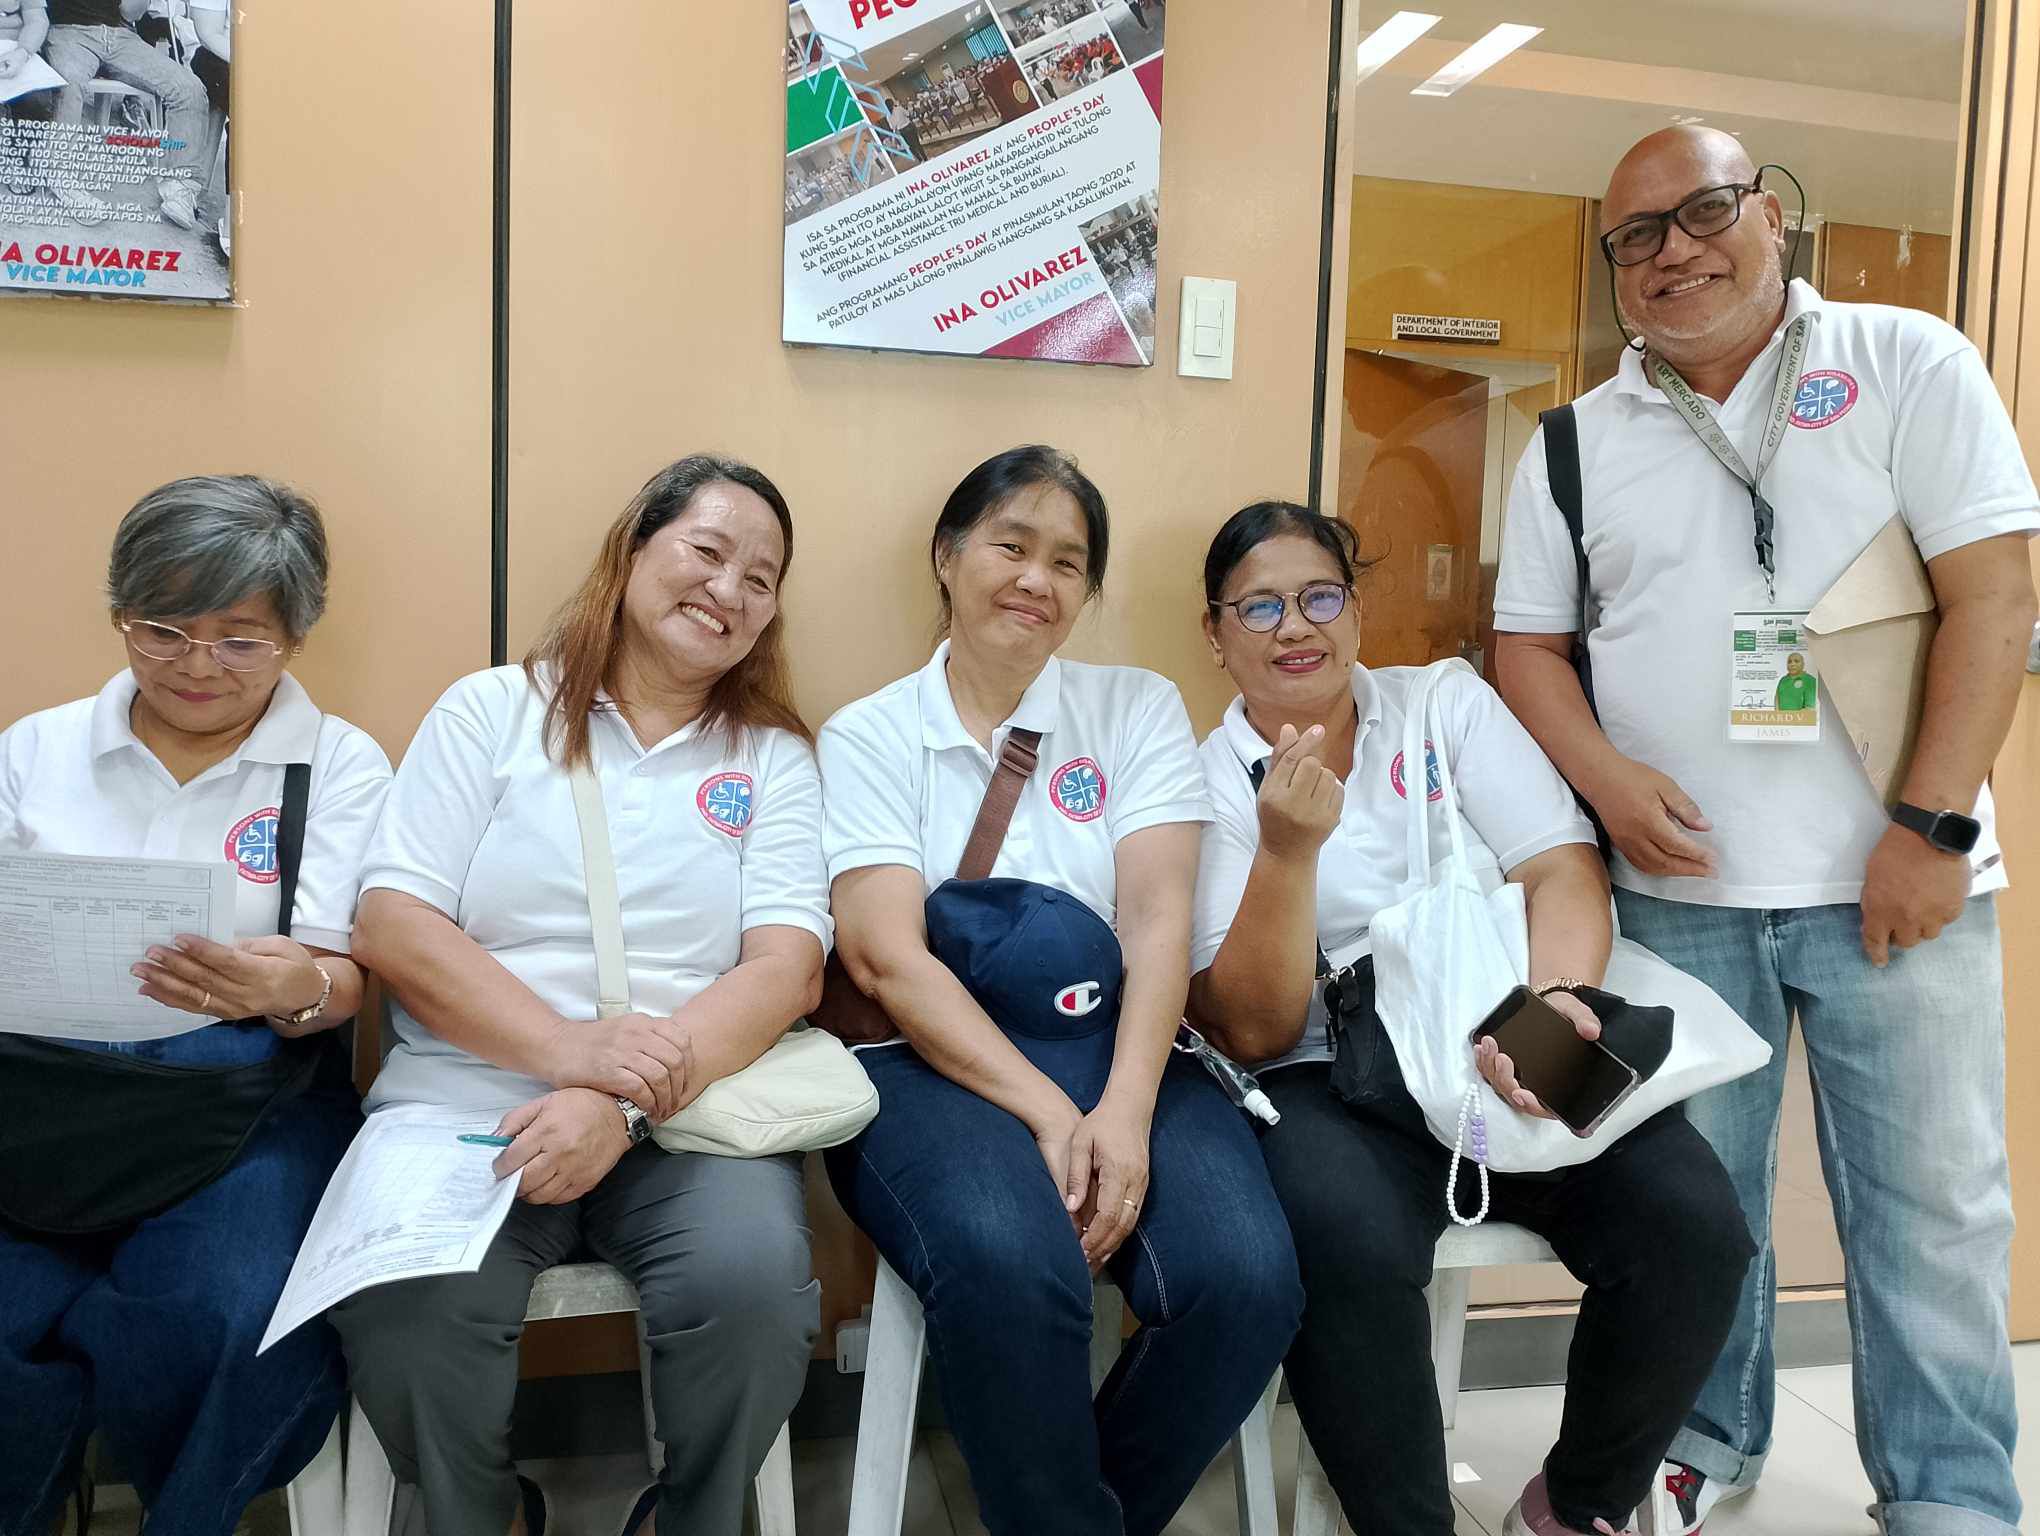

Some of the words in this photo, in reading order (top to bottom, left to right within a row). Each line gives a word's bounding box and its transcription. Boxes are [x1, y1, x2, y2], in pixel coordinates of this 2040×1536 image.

[1, 127, 59, 140] OLIVAREZ
[60, 131, 72, 141] AY
[75, 132, 102, 144] ANG
[17, 118, 84, 133] PROGRAMA
[87, 124, 99, 134] NI
[102, 125, 128, 136] VICE
[130, 127, 169, 139] MAYOR
[14, 137, 46, 149] SAAN
[49, 140, 67, 150] ITO
[71, 142, 86, 152] AY
[87, 143, 145, 156] MAYROON
[147, 148, 164, 158] NG
[29, 148, 50, 158] 100
[53, 150, 113, 163] SCHOLARS
[116, 155, 147, 166] MULA
[61, 160, 123, 174] SINIMULAN
[125, 164, 192, 178] HANGGANG
[81, 171, 96, 181] AT
[98, 172, 146, 185] PATULOY
[807, 231, 823, 243] ISA
[824, 224, 838, 234] SA
[838, 198, 894, 228] PROGRAMA
[894, 191, 905, 201] NI
[905, 179, 929, 195] INA
[931, 149, 991, 183] OLIVAREZ
[993, 144, 1002, 155] AY
[1007, 134, 1026, 149] ANG
[1027, 106, 1081, 138] PEOPLE'S
[1083, 93, 1104, 111] DAY
[800, 241, 828, 260] KUNG
[829, 228, 856, 246] SAAN
[856, 220, 873, 233] ITO
[876, 213, 886, 224] AY
[887, 183, 951, 218] NAGLALAYON
[951, 167, 984, 187] UPANG
[985, 133, 1055, 172] MAKAPAGHATID
[1057, 125, 1072, 138] NG
[1072, 106, 1111, 129] TULONG
[116, 202, 142, 212] MGA
[803, 261, 817, 271] SA
[820, 245, 847, 265] ATING
[848, 235, 872, 250] MGA
[872, 207, 927, 239] KABABAYAN
[960, 179, 984, 196] HIGIT
[986, 174, 1000, 184] SA
[1000, 125, 1099, 178] PANGANGAILANGANG
[36, 206, 50, 216] AY
[54, 207, 143, 222] NAKAPAGTAPOS
[146, 213, 161, 223] NA
[822, 252, 864, 276] MEDIKAL
[866, 244, 876, 256] AT
[877, 234, 901, 250] MGA
[901, 211, 947, 238] NAWALAN
[948, 203, 963, 216] NG
[964, 187, 999, 208] MAHAL
[999, 181, 1013, 191] SA
[1013, 165, 1045, 185] BUHAY.
[838, 252, 891, 282] (FINANCIAL
[894, 224, 947, 256] ASSISTANCE
[947, 215, 965, 229] TRU
[967, 196, 1008, 220] MEDICAL
[1010, 185, 1029, 200] AND
[1030, 167, 1067, 190] BURIAL).
[817, 306, 838, 322] ANG
[839, 272, 908, 311] PROGRAMANG
[909, 244, 964, 277] PEOPLE'S
[965, 232, 987, 249] DAY
[992, 227, 1001, 238] AY
[1003, 196, 1065, 232] PINASIMULAN
[1065, 181, 1098, 201] TAONG
[1099, 168, 1123, 185] 2020
[1126, 161, 1136, 173] AT
[829, 304, 868, 329] PATULOY
[872, 297, 882, 309] AT
[884, 287, 905, 303] MAS
[906, 268, 945, 292] LALONG
[946, 243, 996, 272] PINALAWIG
[997, 216, 1052, 248] HANGGANG
[1053, 210, 1067, 220] SA
[1067, 177, 1134, 214] KASALUKUYAN.
[35, 244, 182, 272] OLIVAREZ
[6, 263, 61, 282] VICE
[66, 268, 146, 287] MAYOR
[933, 303, 978, 332] INA
[980, 246, 1088, 308] OLIVAREZ
[995, 300, 1035, 326] VICE
[1036, 272, 1095, 308] MAYOR
[1397, 315, 1447, 326] DEPARTMENT
[1462, 320, 1499, 329] INTERIOR
[1397, 325, 1414, 333] AND
[1416, 326, 1442, 335] LOCAL
[1444, 328, 1498, 338] GOVERNMENT
[1668, 376, 1705, 419] MERCADO
[1767, 422, 1779, 447] CITY
[1775, 354, 1798, 421] GOVERNMENT
[1792, 338, 1801, 352] OF
[1741, 712, 1793, 722] RICHARD
[1757, 727, 1791, 738] JAMES
